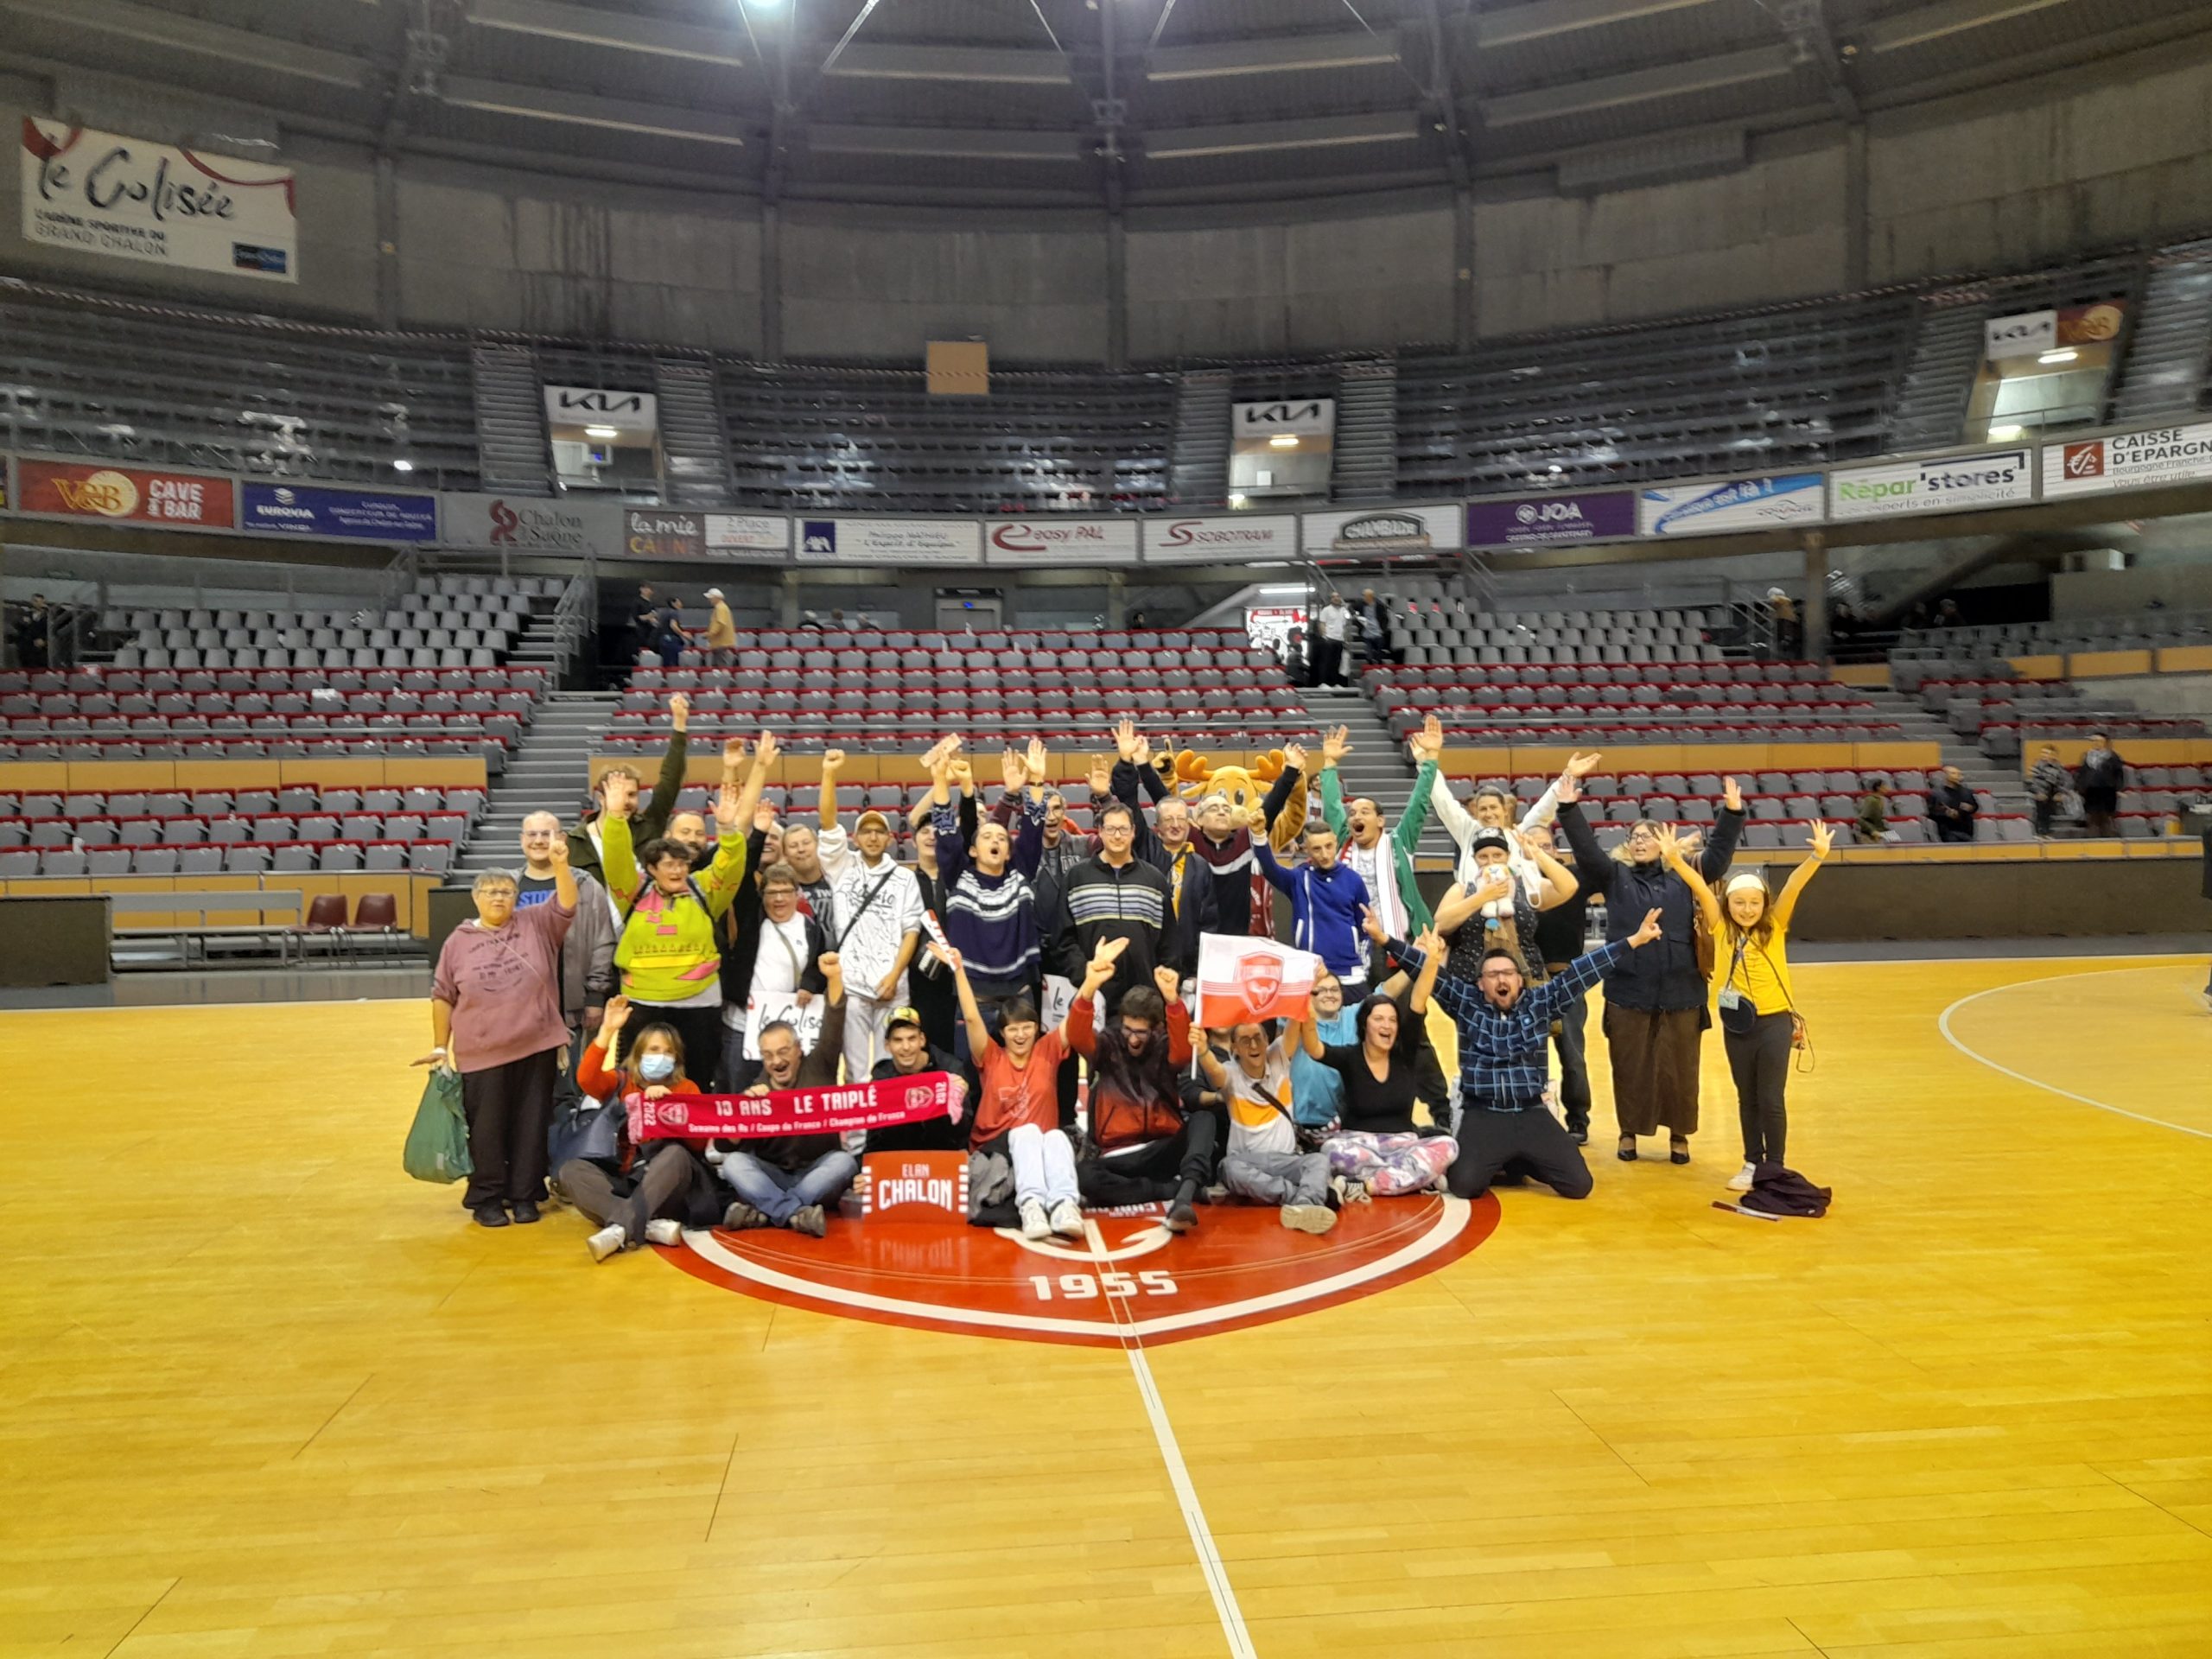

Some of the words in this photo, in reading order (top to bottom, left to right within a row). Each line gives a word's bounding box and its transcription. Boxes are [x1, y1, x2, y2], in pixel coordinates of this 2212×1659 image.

[559, 391, 640, 412] KIA
[1245, 402, 1320, 423] KIA
[2113, 429, 2183, 450] CAISSE
[149, 479, 206, 504] CAVE
[163, 499, 203, 520] BAR
[256, 505, 315, 520] EUROVIA
[518, 509, 583, 529] Chalon
[1538, 501, 1584, 522] JOA
[631, 512, 656, 534] la
[656, 515, 700, 536] mie
[630, 536, 698, 555] CALNE
[714, 1100, 734, 1116] 13
[739, 1098, 772, 1116] ANS
[793, 1095, 814, 1115] LE
[821, 1084, 878, 1111] TRIPLÉ
[721, 1123, 737, 1134] des
[756, 1122, 781, 1134] Coupe
[781, 1122, 793, 1131] de
[793, 1121, 821, 1130] France
[829, 1116, 865, 1128] Champion
[866, 1114, 878, 1123] de
[878, 1111, 906, 1122] France
[902, 1163, 931, 1179] ELAN
[878, 1179, 953, 1212] CHALON
[1028, 1270, 1179, 1301] 1955
